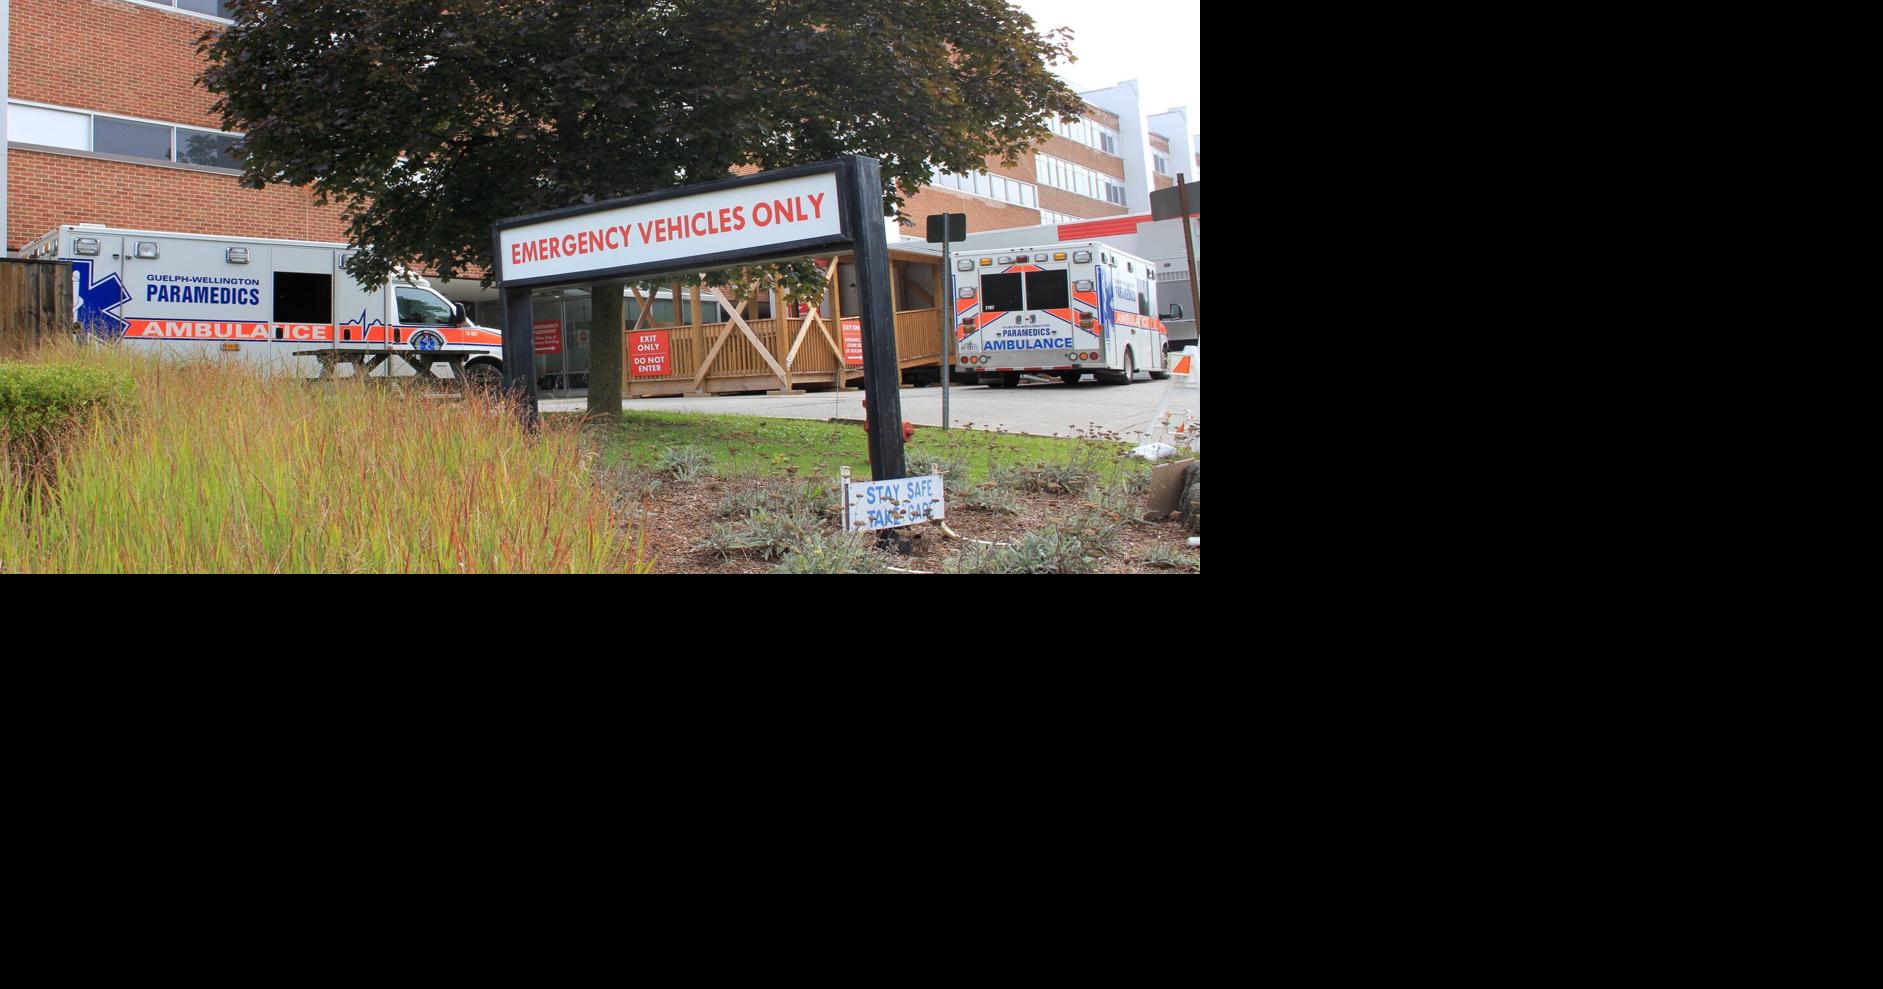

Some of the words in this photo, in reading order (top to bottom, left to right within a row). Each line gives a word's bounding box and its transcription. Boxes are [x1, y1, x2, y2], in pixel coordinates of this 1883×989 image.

[511, 224, 632, 265] EMERGENCY
[638, 206, 745, 244] VEHICLES
[752, 192, 825, 227] ONLY
[146, 274, 260, 286] GUELPH-WELLINGTON
[146, 284, 260, 305] PARAMEDICS
[142, 321, 327, 340] AMBULANCE
[1002, 328, 1051, 337] PARAMEDICS
[640, 335, 657, 343] EXIT
[984, 338, 1072, 351] AMBULANCE
[637, 344, 659, 352] ONLY
[648, 356, 665, 364] NOT
[638, 364, 662, 372] ENTER
[866, 484, 899, 504] STAY
[907, 479, 932, 499] SAFE
[866, 507, 901, 529] TAKE
